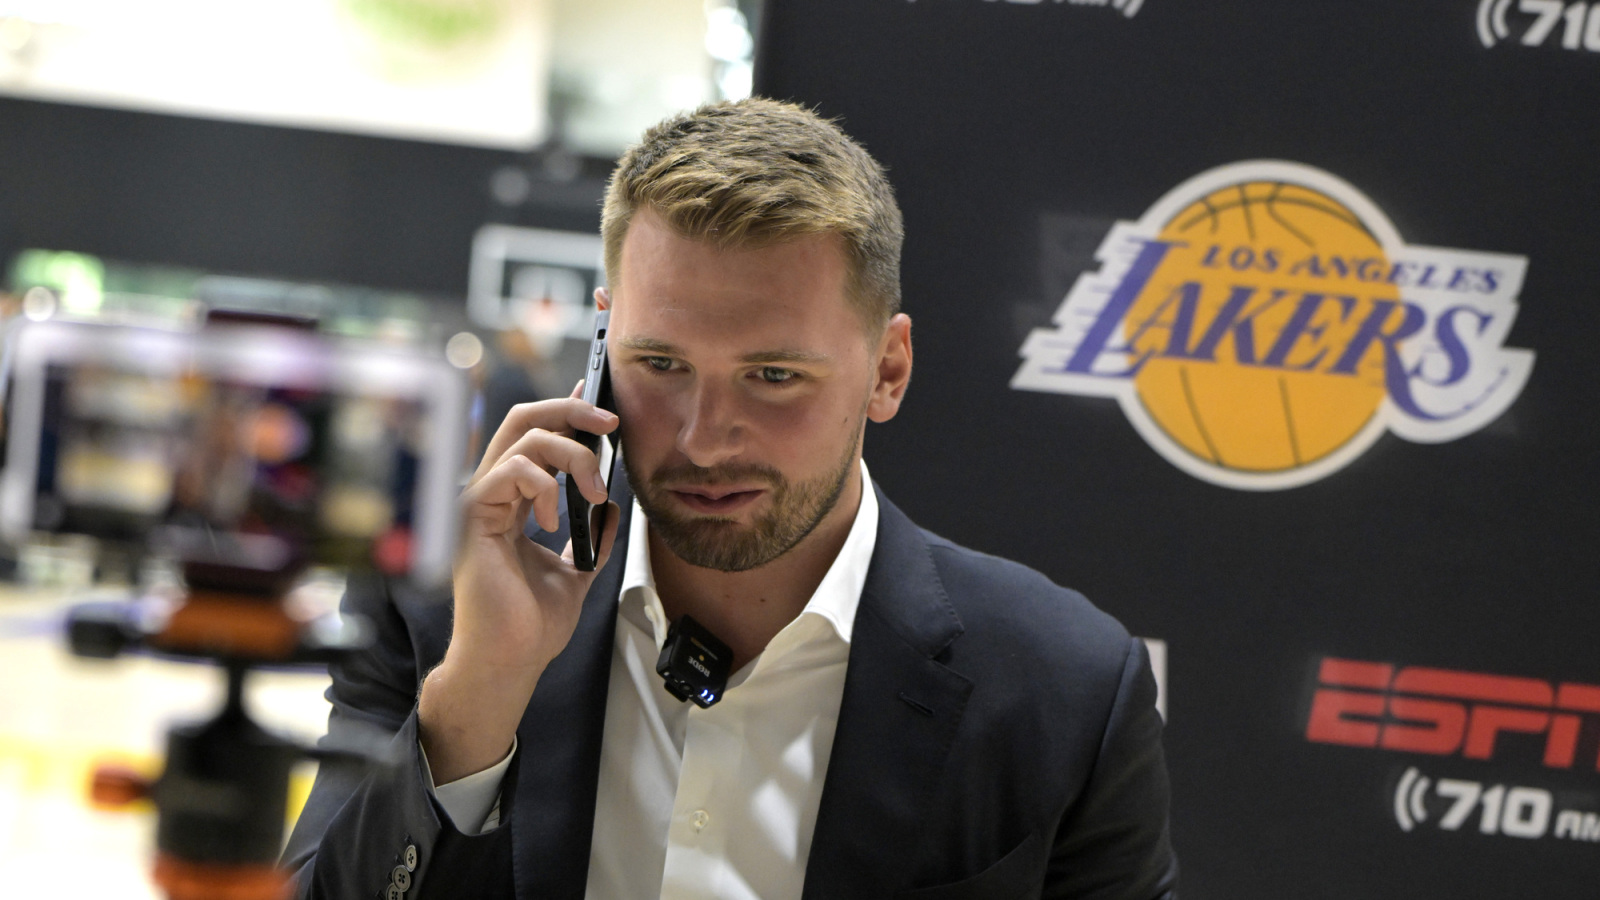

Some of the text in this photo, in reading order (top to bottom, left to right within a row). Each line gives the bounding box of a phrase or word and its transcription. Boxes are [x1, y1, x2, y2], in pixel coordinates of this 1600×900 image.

[1200, 243, 1503, 294] LOS ANGELES
[1040, 235, 1510, 422] LAKERS
[1436, 778, 1552, 839] 710
